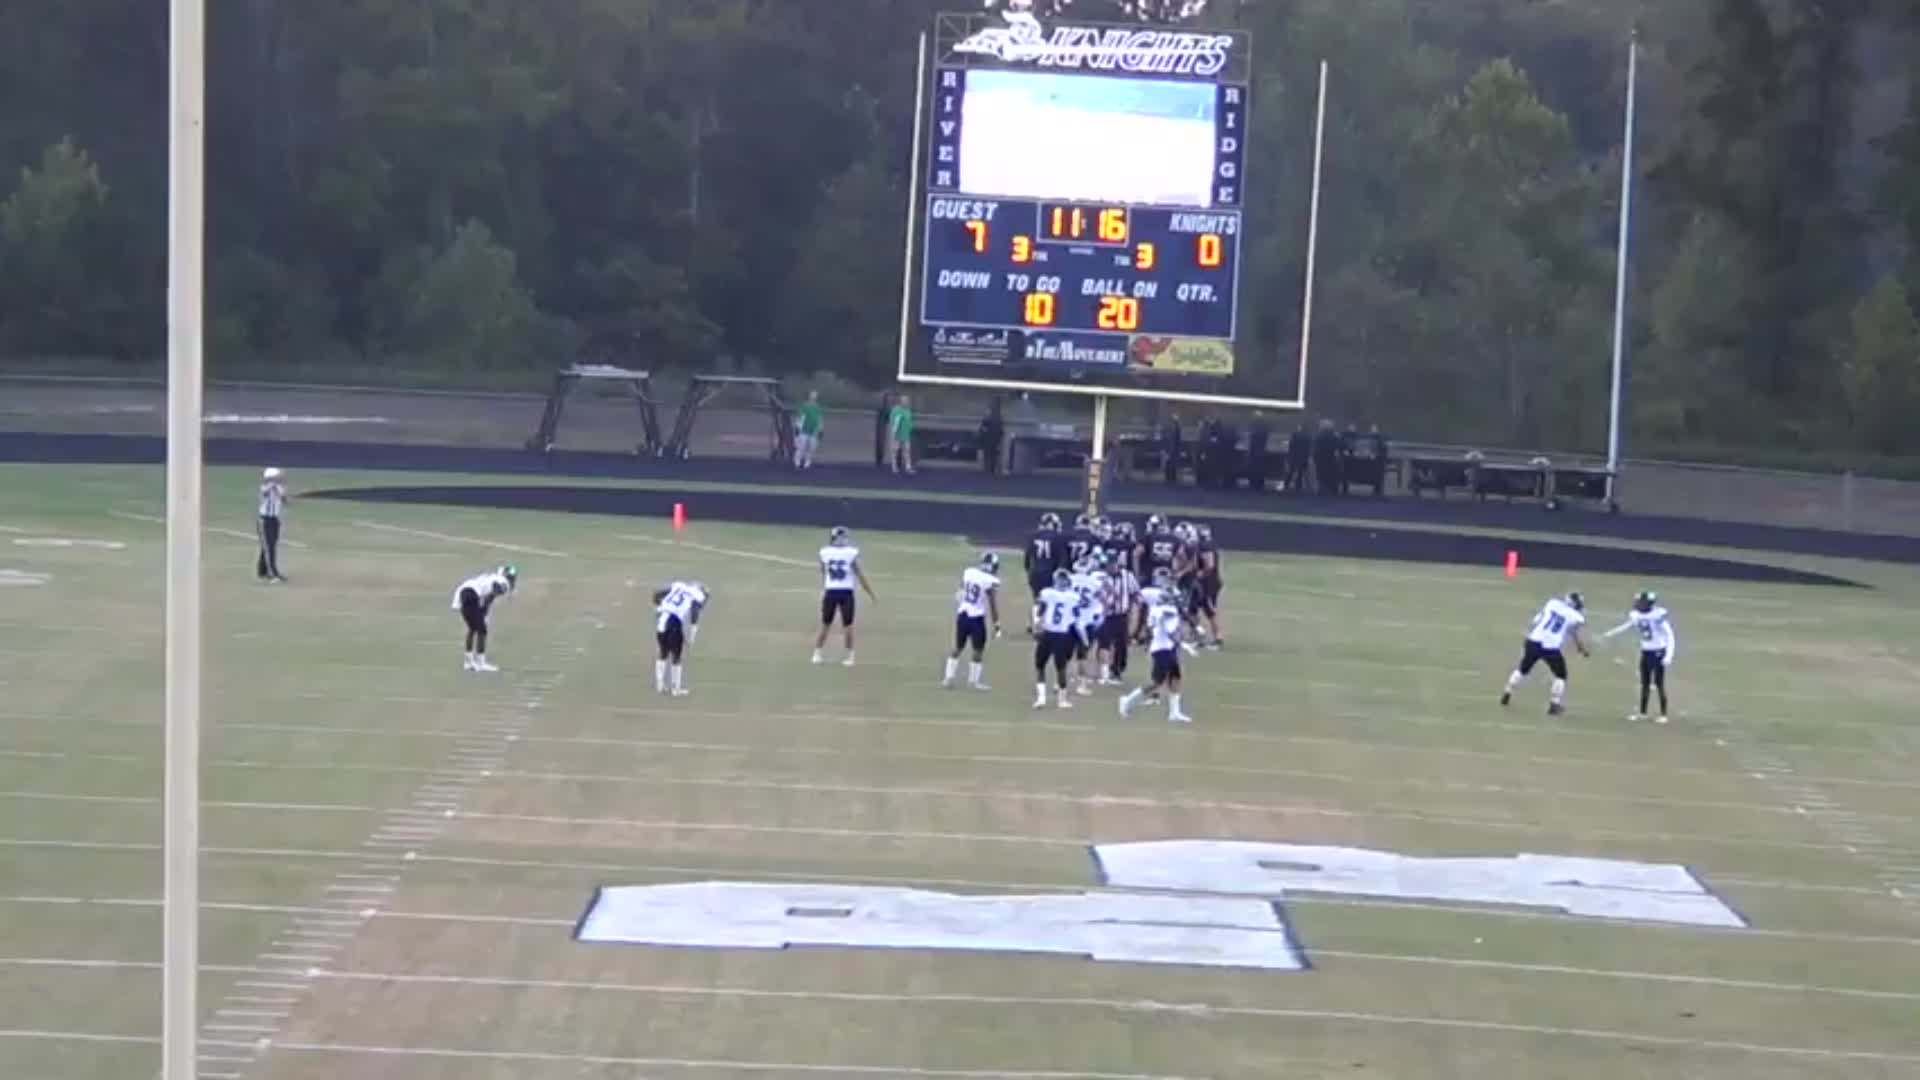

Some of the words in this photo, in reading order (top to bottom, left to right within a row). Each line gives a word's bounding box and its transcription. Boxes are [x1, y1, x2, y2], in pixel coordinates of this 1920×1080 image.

[1040, 27, 1233, 75] KNIGHTS
[935, 70, 957, 187] RIVER
[1218, 88, 1241, 203] RIDGE
[932, 200, 998, 221] GUEST
[965, 221, 985, 252] 7
[1169, 213, 1236, 235] KNIGHTS
[1011, 235, 1029, 262] 3
[1136, 243, 1153, 269] 3
[1199, 234, 1220, 266] 0
[938, 270, 990, 288] DOWN
[1007, 274, 1029, 291] TO
[1036, 275, 1061, 293] GO
[1081, 278, 1125, 296] BALL
[1133, 281, 1158, 298] ON
[1176, 283, 1218, 302] QTR.
[1025, 293, 1053, 324] 10
[1098, 297, 1138, 330] 20
[1033, 539, 1051, 559] 71
[1052, 602, 1065, 625] 6
